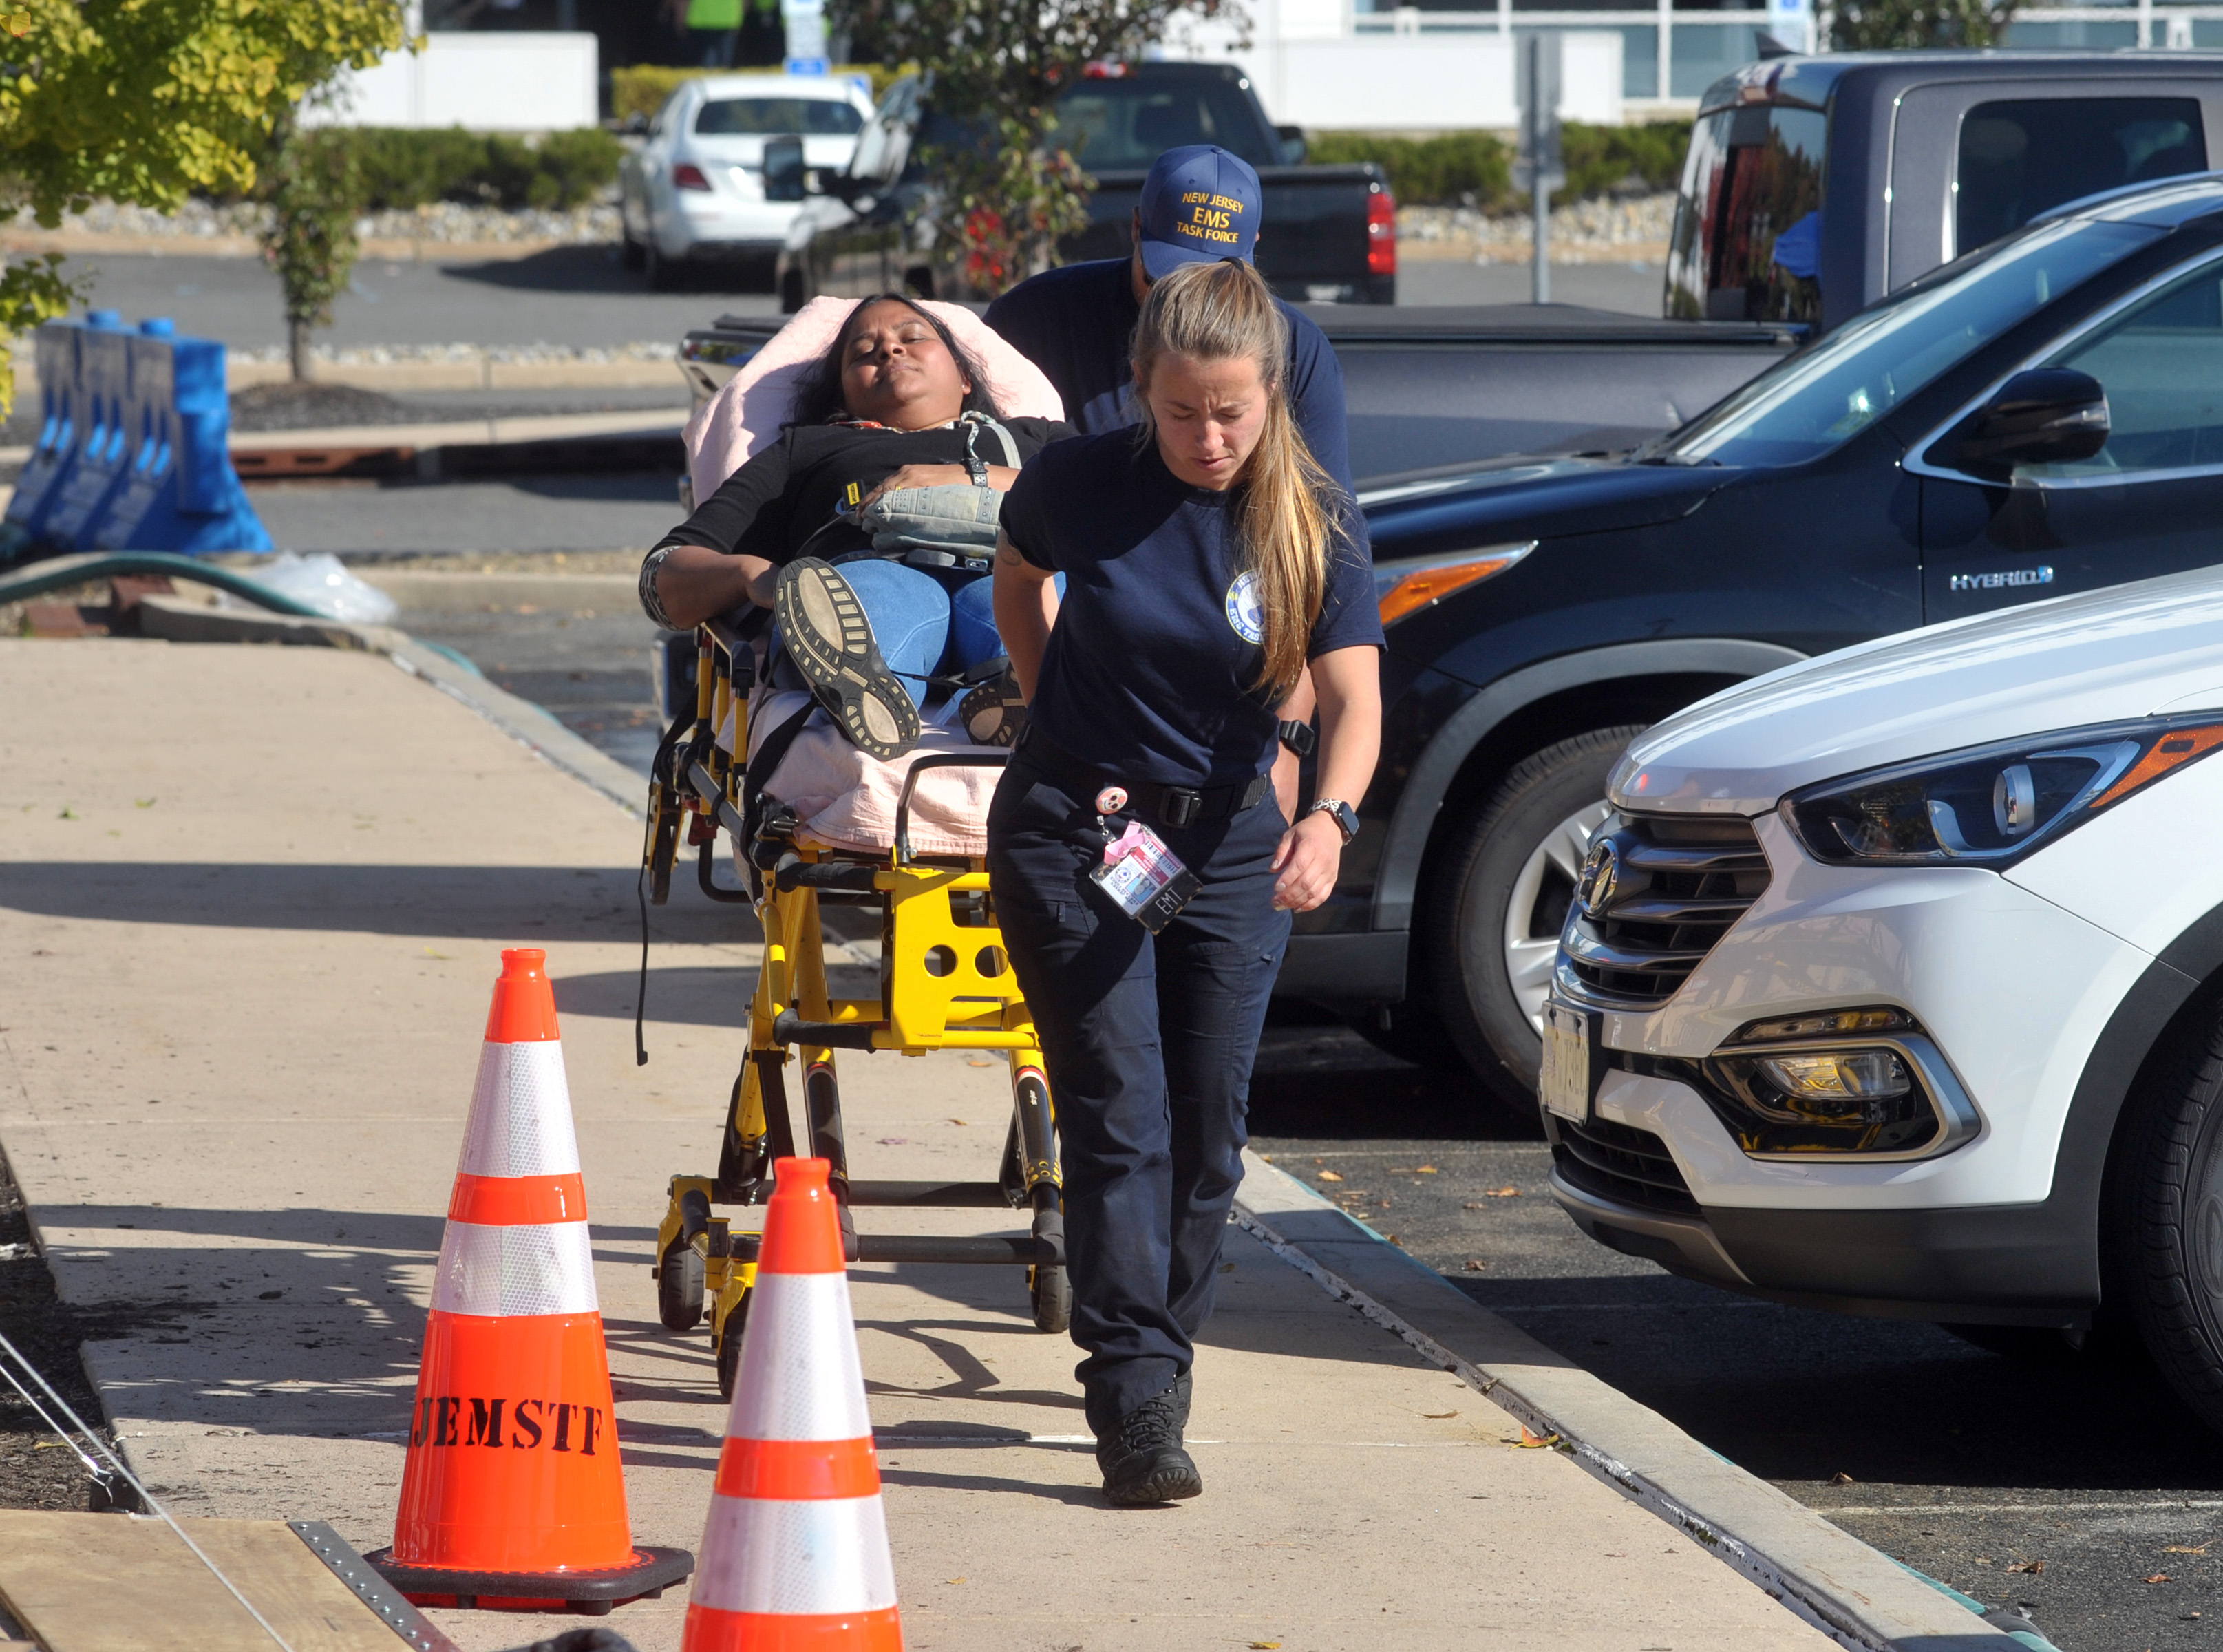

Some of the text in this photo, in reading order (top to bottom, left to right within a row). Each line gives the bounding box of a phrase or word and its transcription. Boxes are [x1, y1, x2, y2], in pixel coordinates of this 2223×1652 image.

[1182, 192, 1244, 214] NEW JERSEY
[1193, 207, 1231, 229] EMS
[1177, 222, 1239, 243] TASK FORCE
[1950, 570, 2036, 591] HYBRID
[1243, 627, 1260, 641] TAS
[1155, 885, 1183, 915] EMT
